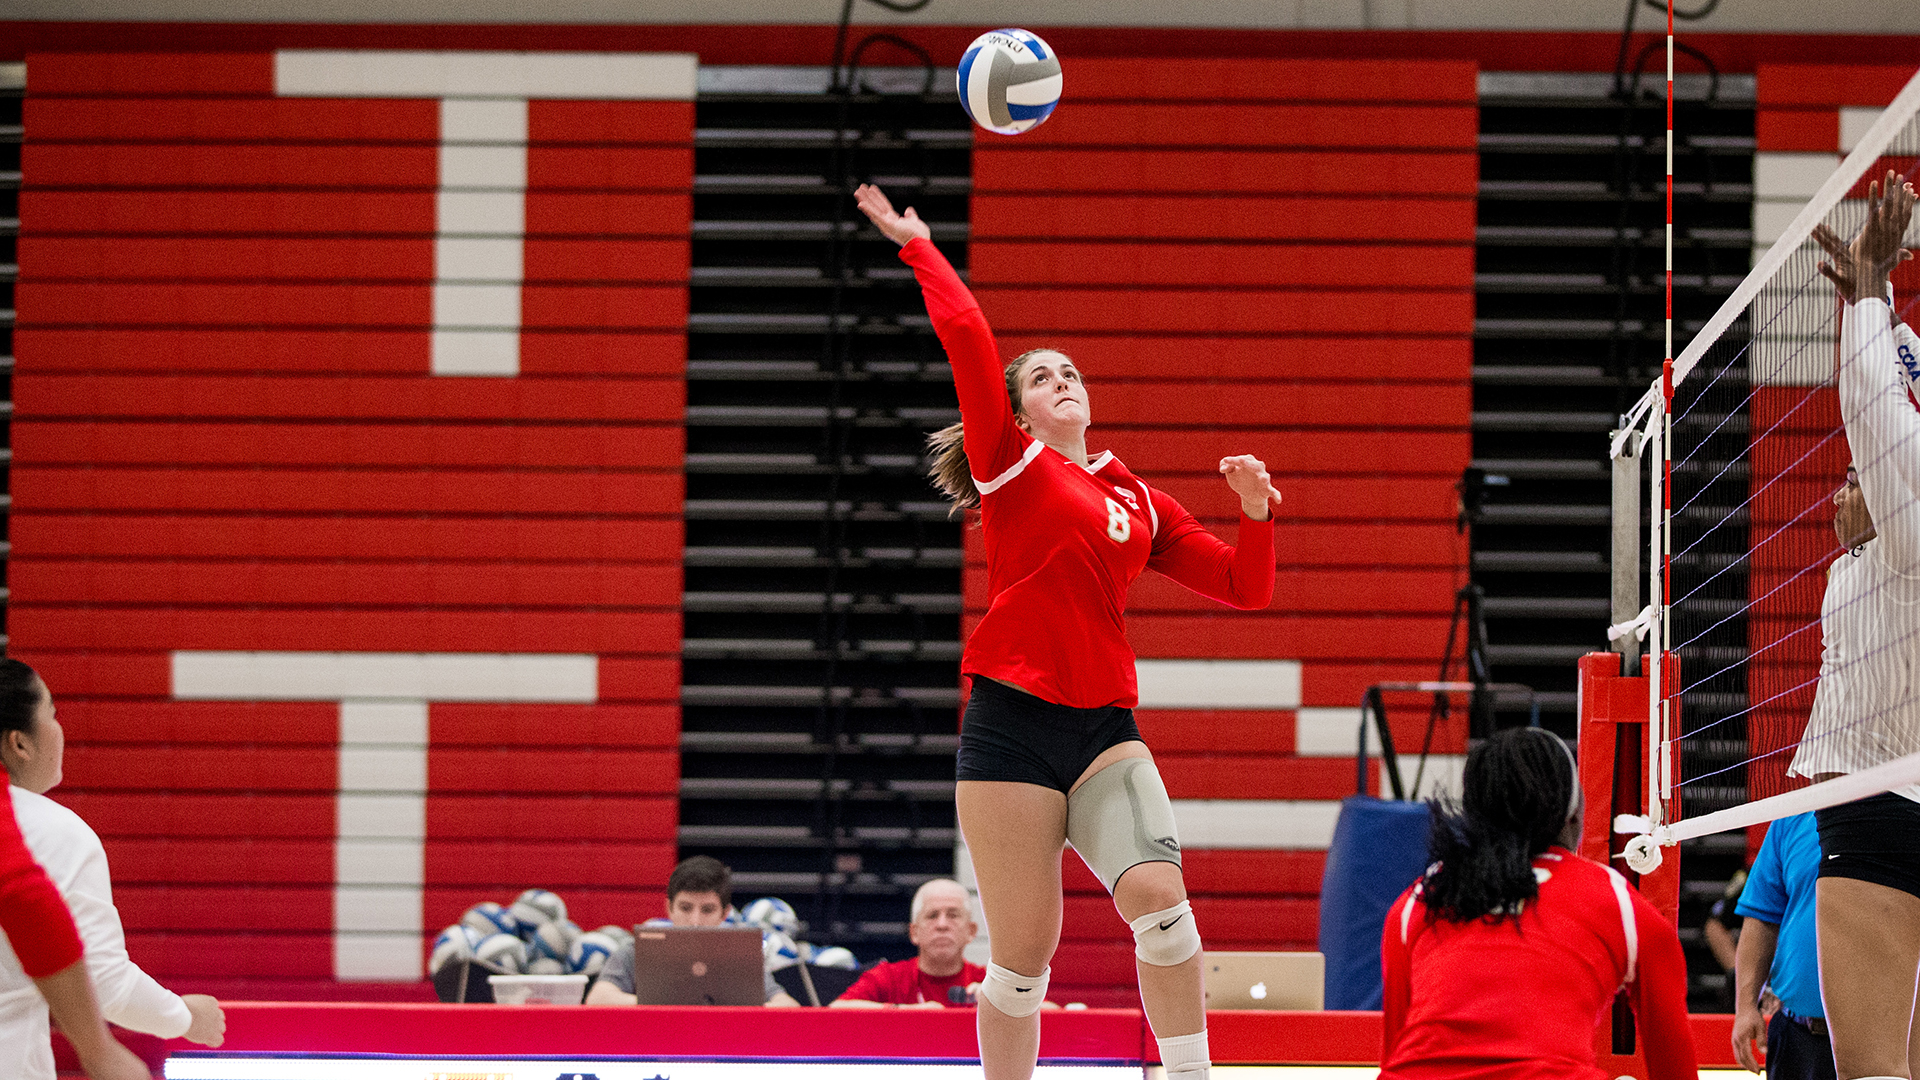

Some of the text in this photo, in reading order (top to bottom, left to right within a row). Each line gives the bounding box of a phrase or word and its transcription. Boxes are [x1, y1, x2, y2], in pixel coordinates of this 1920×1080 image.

[273, 50, 698, 377] T
[1105, 497, 1130, 543] 8
[171, 650, 597, 982] T
